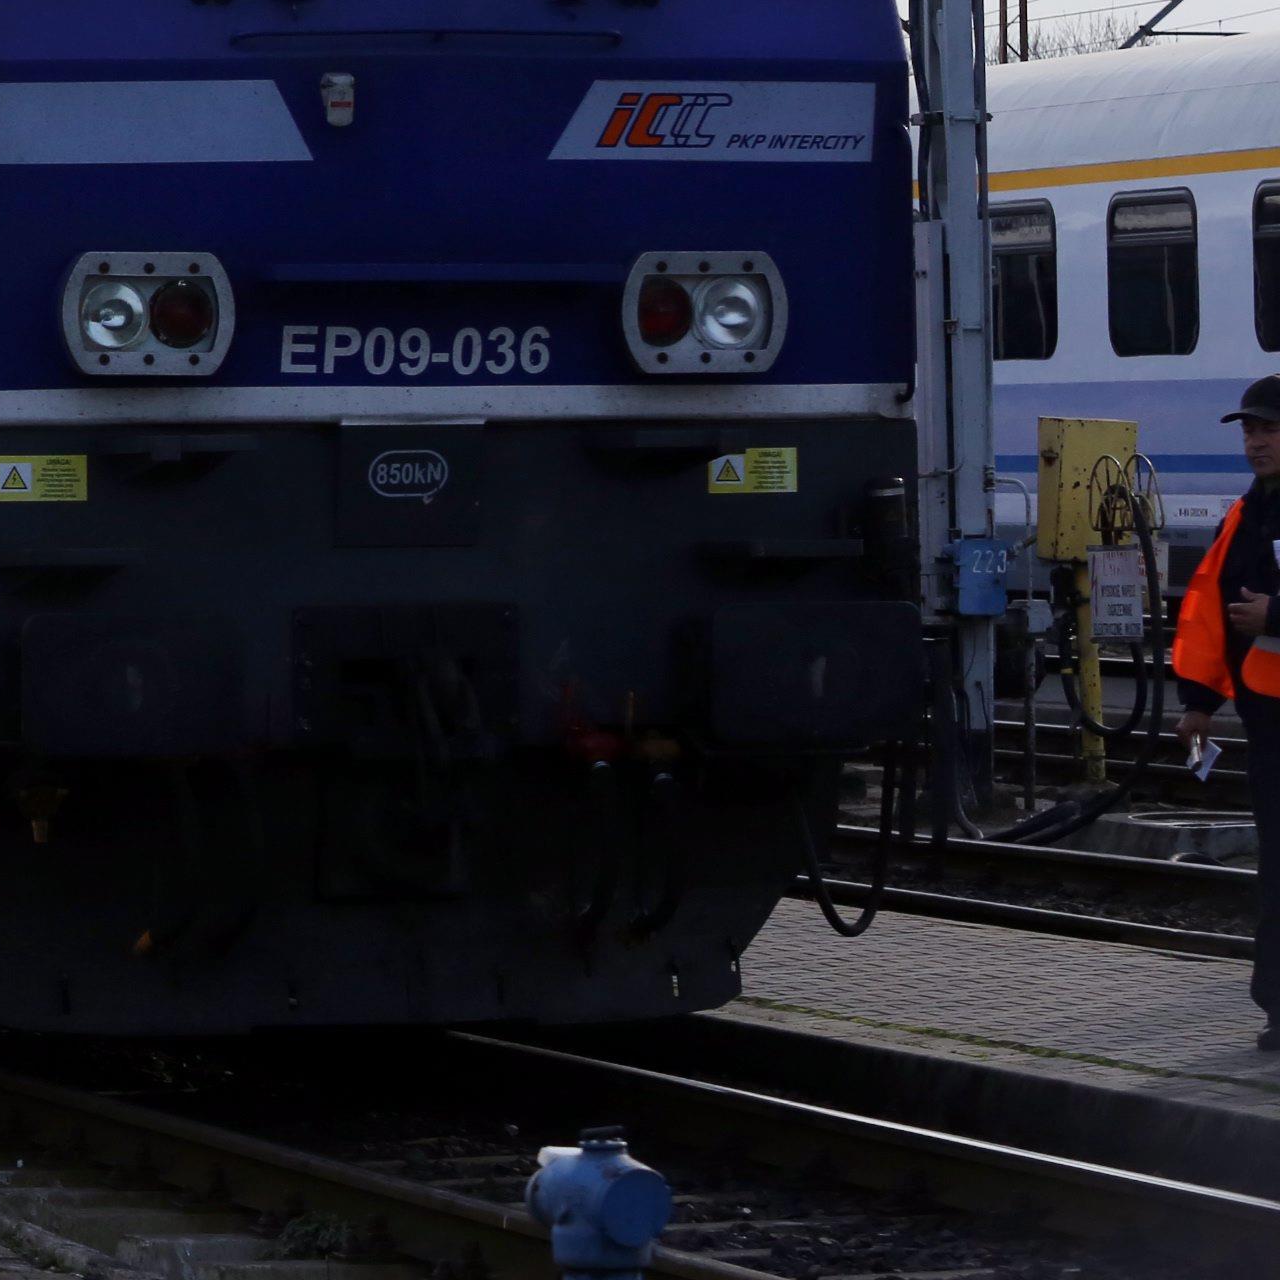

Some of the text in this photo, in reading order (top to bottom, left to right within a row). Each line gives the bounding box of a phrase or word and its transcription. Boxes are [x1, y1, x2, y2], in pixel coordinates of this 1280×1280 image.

[726, 133, 866, 150] PKP INTERCITY
[280, 325, 551, 375] EP09-036
[376, 463, 441, 485] 850kN
[972, 549, 1007, 573] 223
